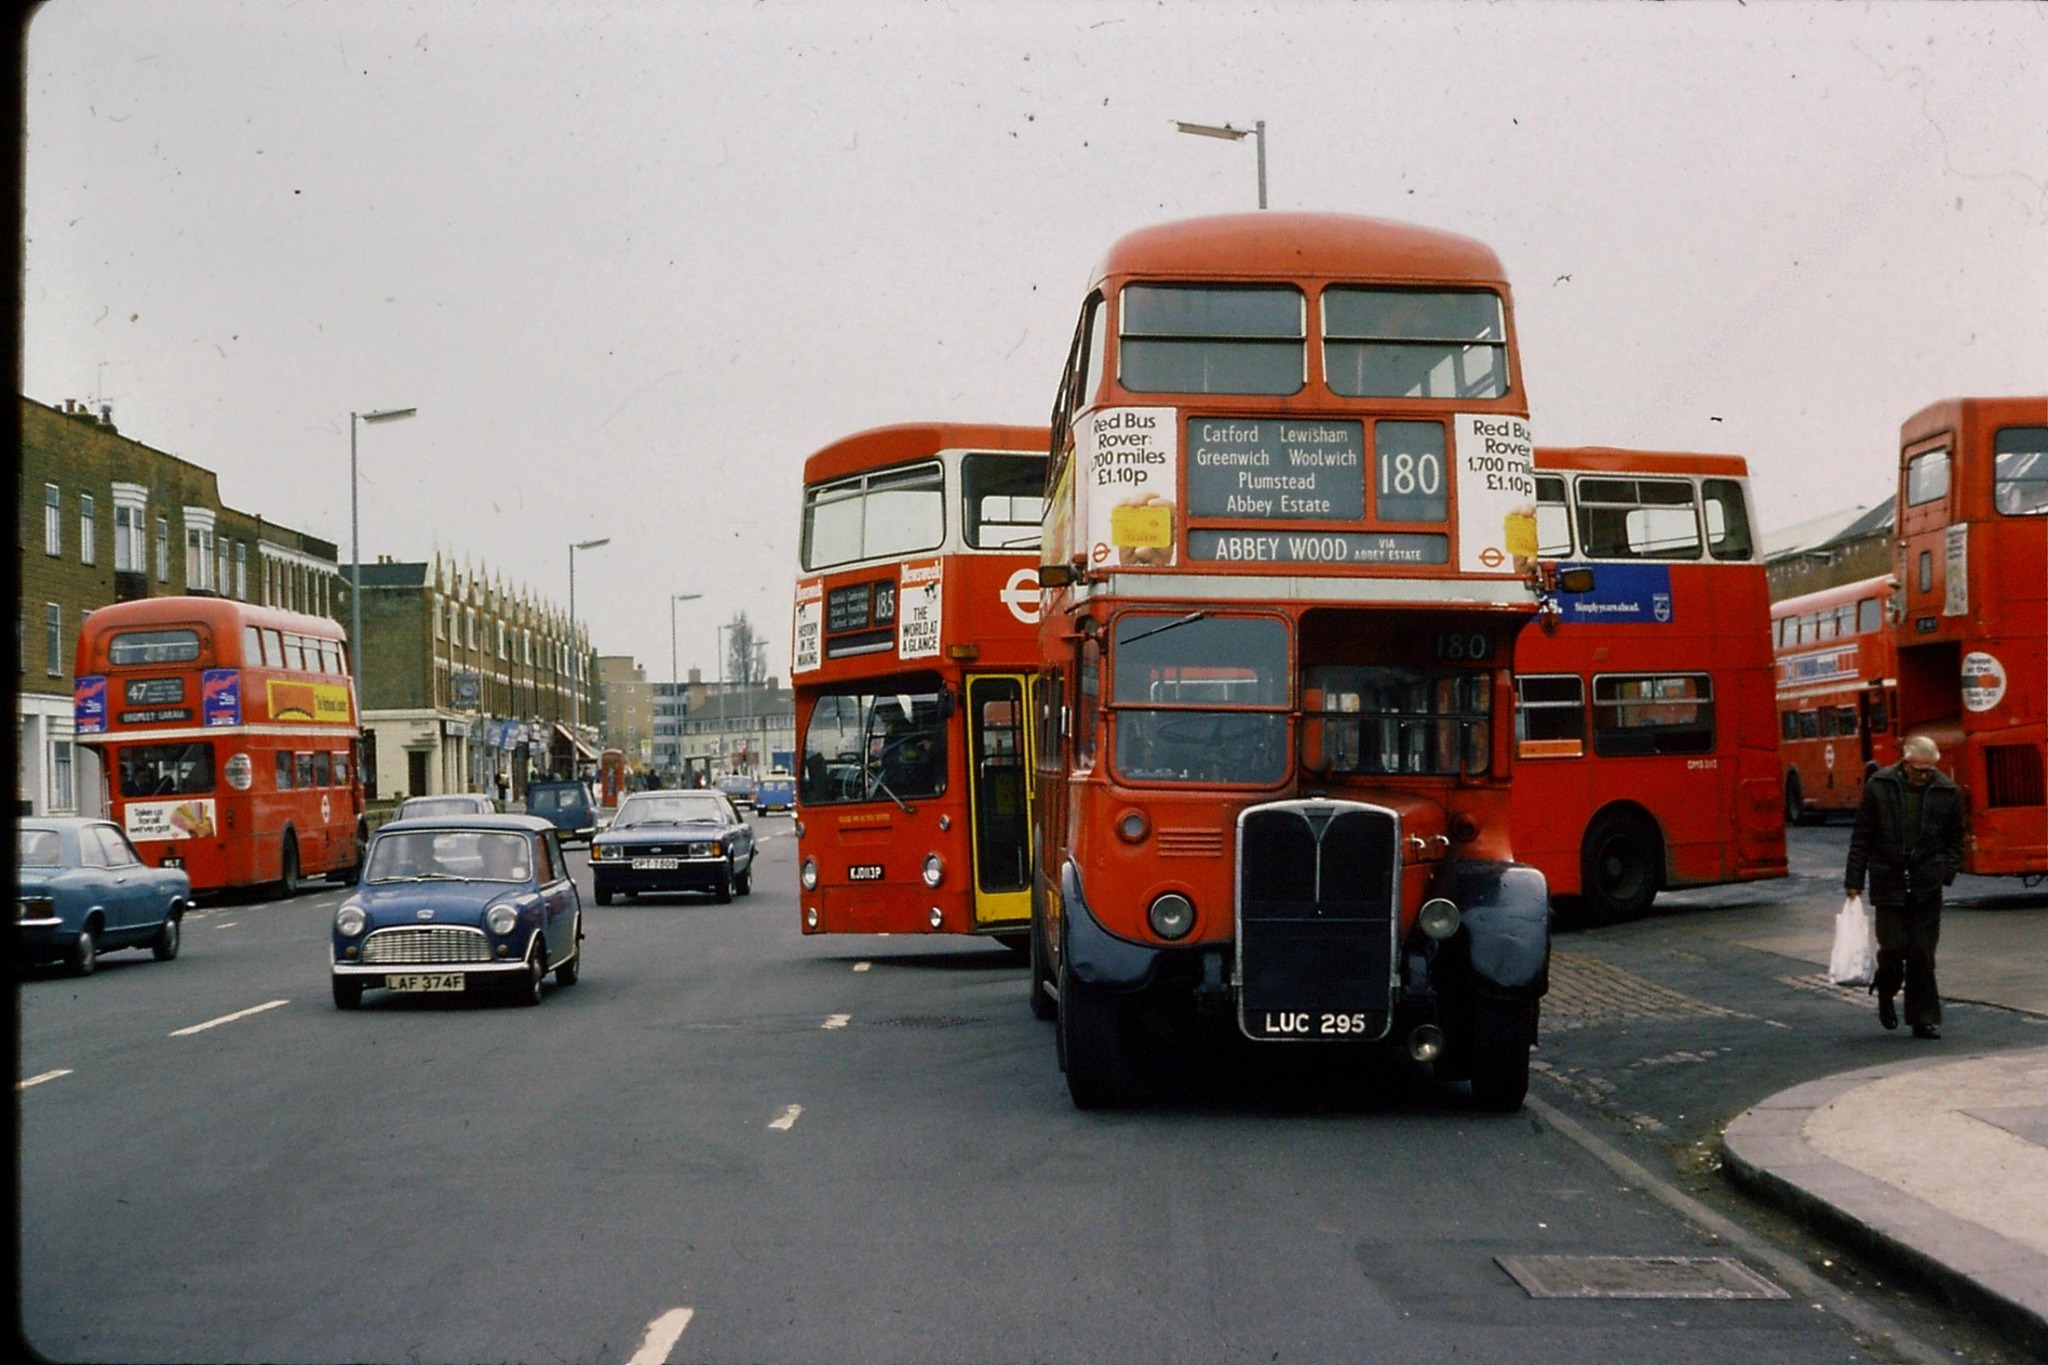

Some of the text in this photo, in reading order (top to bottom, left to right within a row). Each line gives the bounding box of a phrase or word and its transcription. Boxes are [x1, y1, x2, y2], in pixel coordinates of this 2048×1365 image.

[1125, 413, 1156, 429] Bus
[1473, 420, 1509, 436] Red
[1203, 425, 1348, 443] Catford Lewisham
[1117, 448, 1166, 464] miles
[1197, 448, 1357, 466] Greenwich Woolwich
[1467, 457, 1504, 473] 1,700
[1098, 467, 1148, 486] £1.10p
[1239, 471, 1315, 490] Plumstead
[1381, 453, 1440, 494] 180
[1486, 474, 1533, 496] £1.10p
[1227, 495, 1331, 517] Abbey Estate
[1215, 537, 1348, 561] ABBEY WOOD
[1379, 538, 1395, 549] VIA
[1354, 550, 1422, 561] ABBEY ESTATE
[875, 589, 894, 618] 185
[914, 606, 928, 621] THE
[903, 620, 938, 638] WORLD AT
[902, 635, 938, 653] A GLANCE
[127, 683, 148, 701] 47
[388, 975, 462, 990] LAF 374F
[1265, 1012, 1366, 1033] LUC 295
